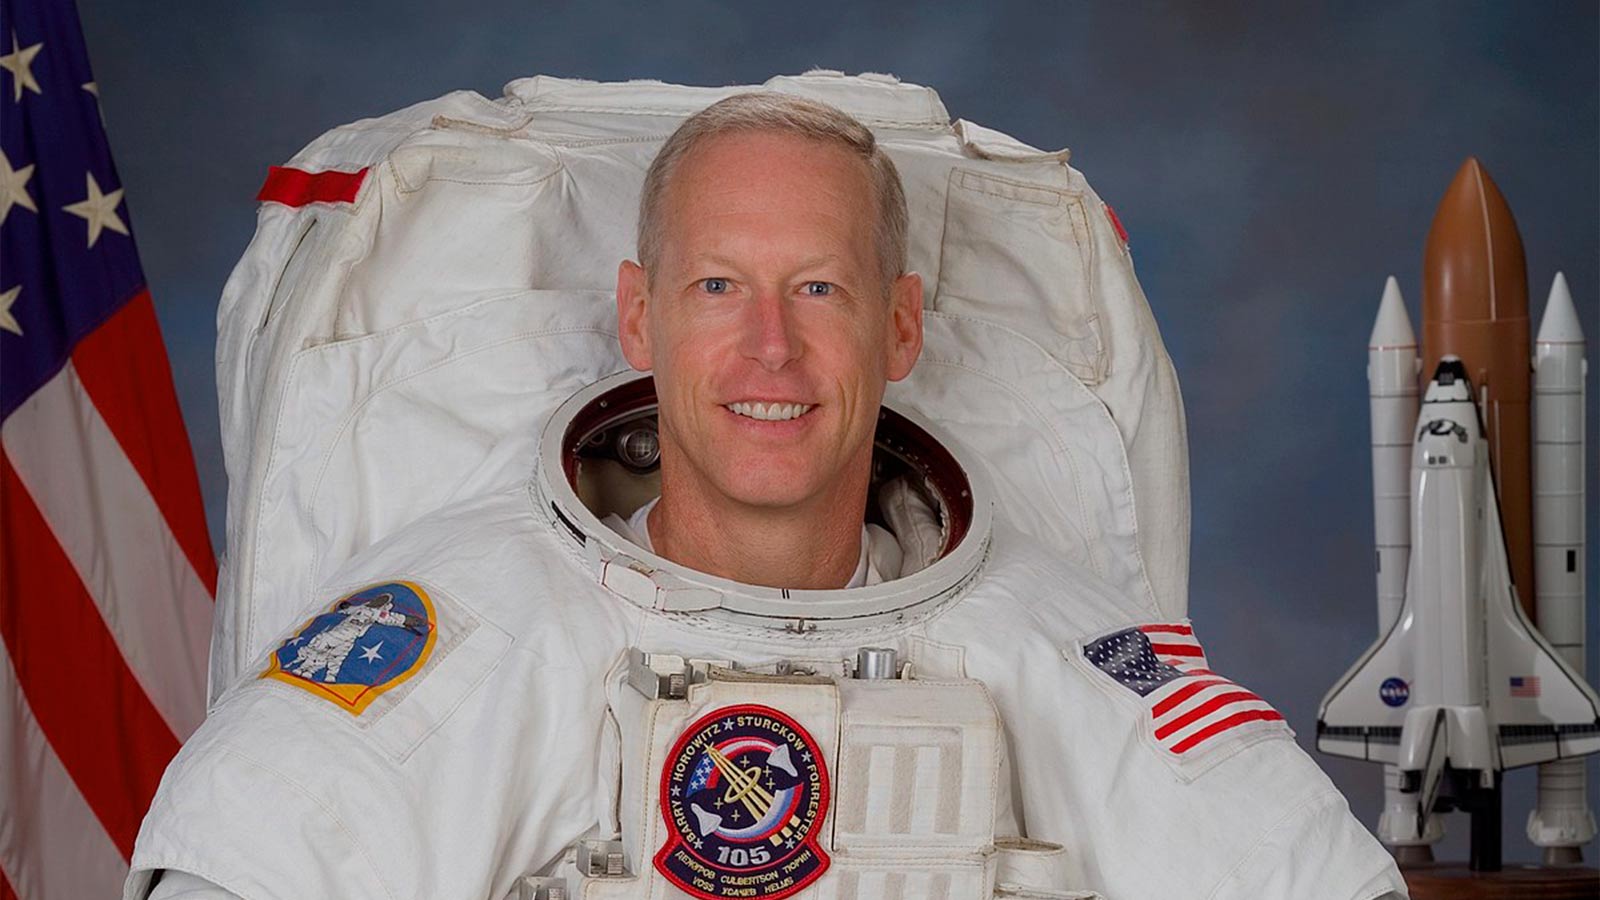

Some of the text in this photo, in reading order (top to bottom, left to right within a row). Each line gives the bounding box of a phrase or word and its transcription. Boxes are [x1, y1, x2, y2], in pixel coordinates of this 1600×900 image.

[671, 716, 821, 844] BARRY HOROWITZ STURCKOW FORRESTER
[717, 846, 771, 867] 105
[692, 876, 715, 892] VOSS
[764, 877, 794, 893] HELMS
[721, 870, 779, 884] CULBERTSON
